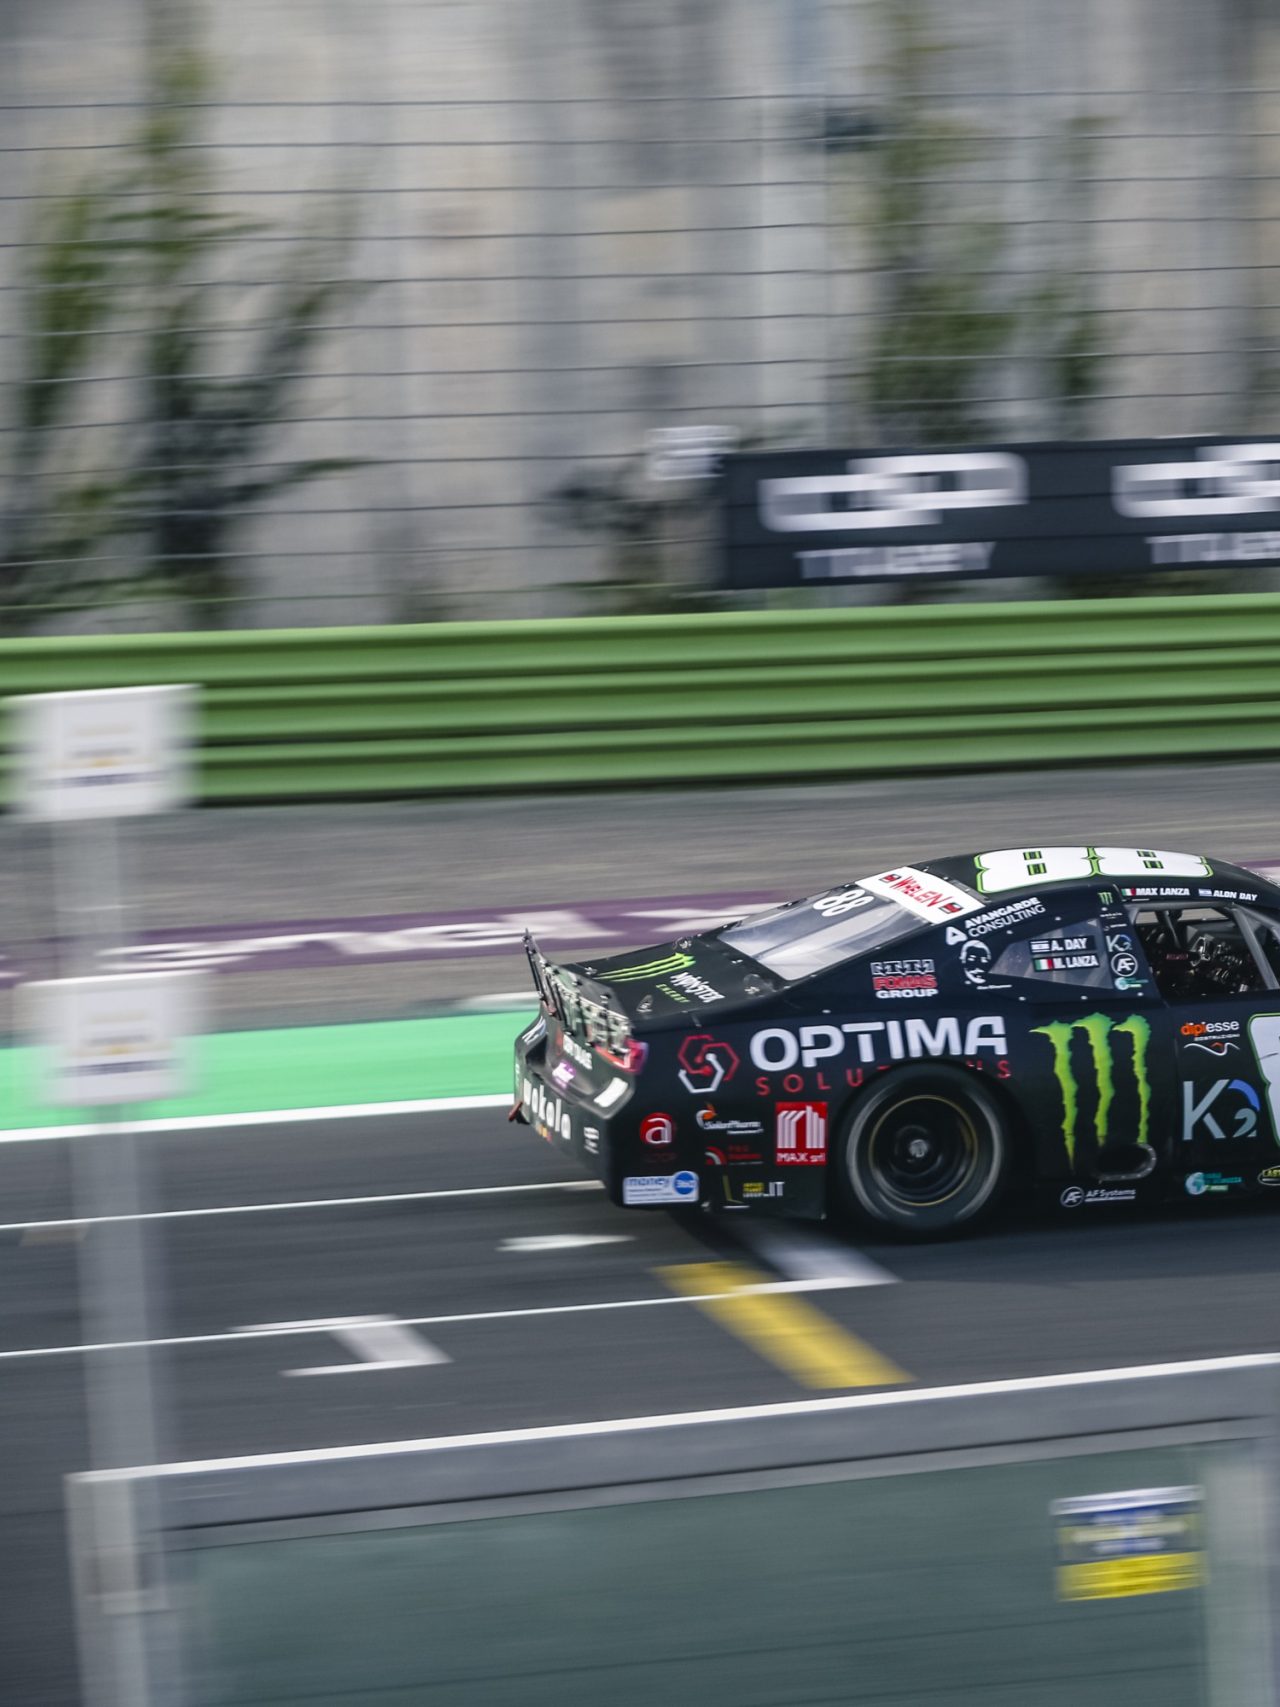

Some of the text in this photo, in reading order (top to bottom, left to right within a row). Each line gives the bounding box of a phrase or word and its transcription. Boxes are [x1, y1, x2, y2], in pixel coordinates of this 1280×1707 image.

[1135, 887, 1191, 897] MAX LANZA
[1213, 889, 1258, 901] ALON DAY
[813, 889, 875, 917] 88
[965, 896, 1041, 929] AVANGARDE
[968, 904, 1046, 938] CONSULTING
[1065, 937, 1088, 951] DAY
[1065, 955, 1099, 968] LANZA
[876, 988, 939, 999] GROUP
[1181, 1020, 1240, 1036] dipiesse
[750, 1016, 1008, 1072] OPTIMA
